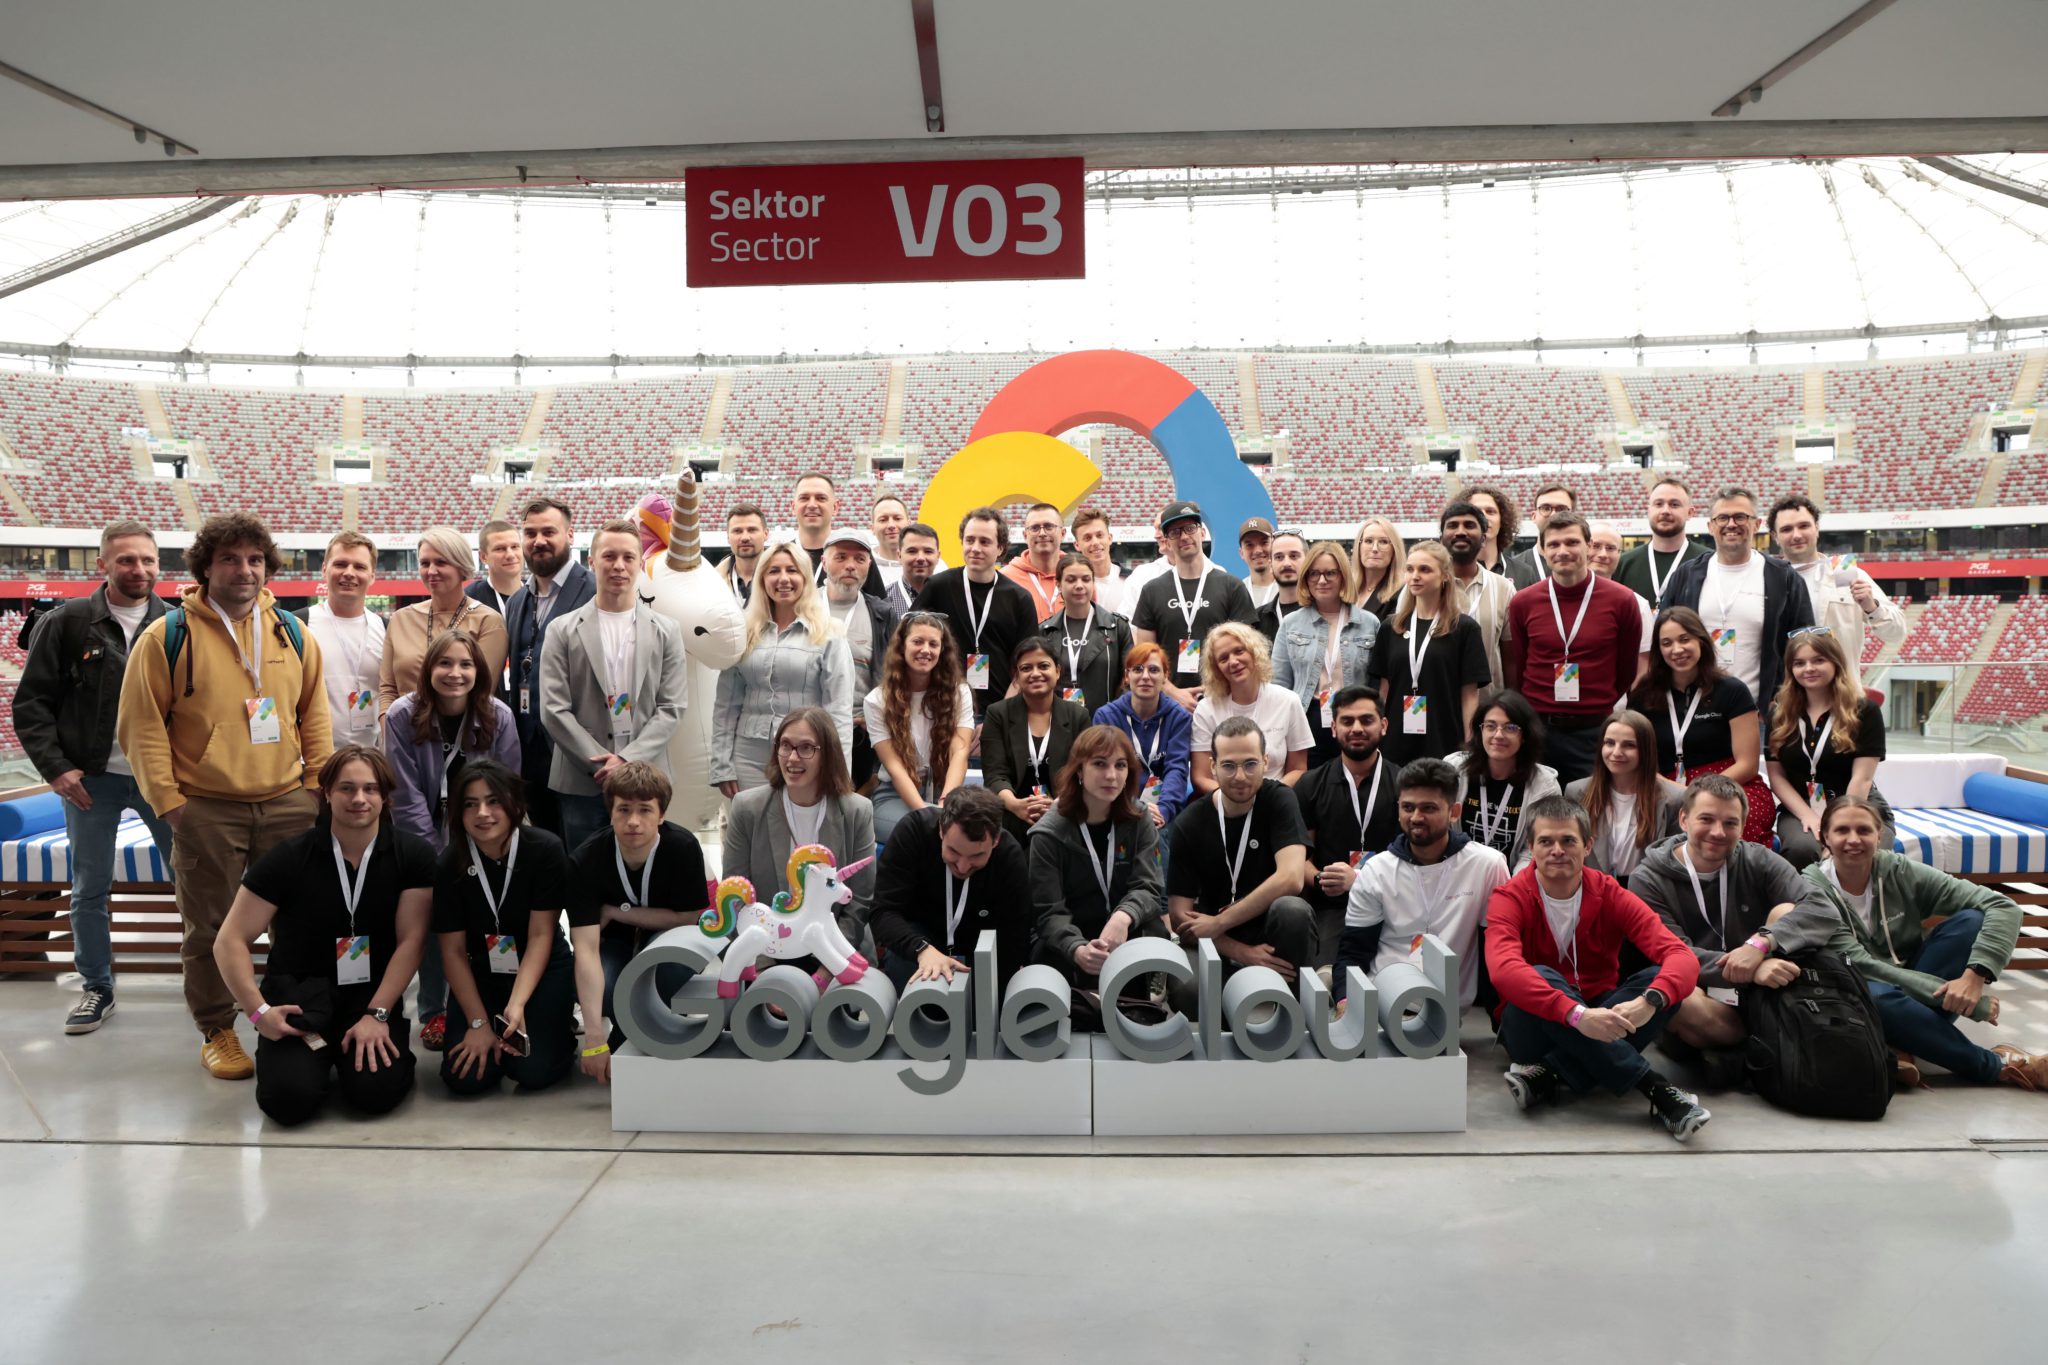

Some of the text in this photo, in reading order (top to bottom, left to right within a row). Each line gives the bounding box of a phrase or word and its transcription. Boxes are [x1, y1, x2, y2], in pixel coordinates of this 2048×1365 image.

[709, 188, 826, 221] Sektor
[709, 231, 821, 263] Sector
[613, 929, 1460, 1096] Google Cloud
